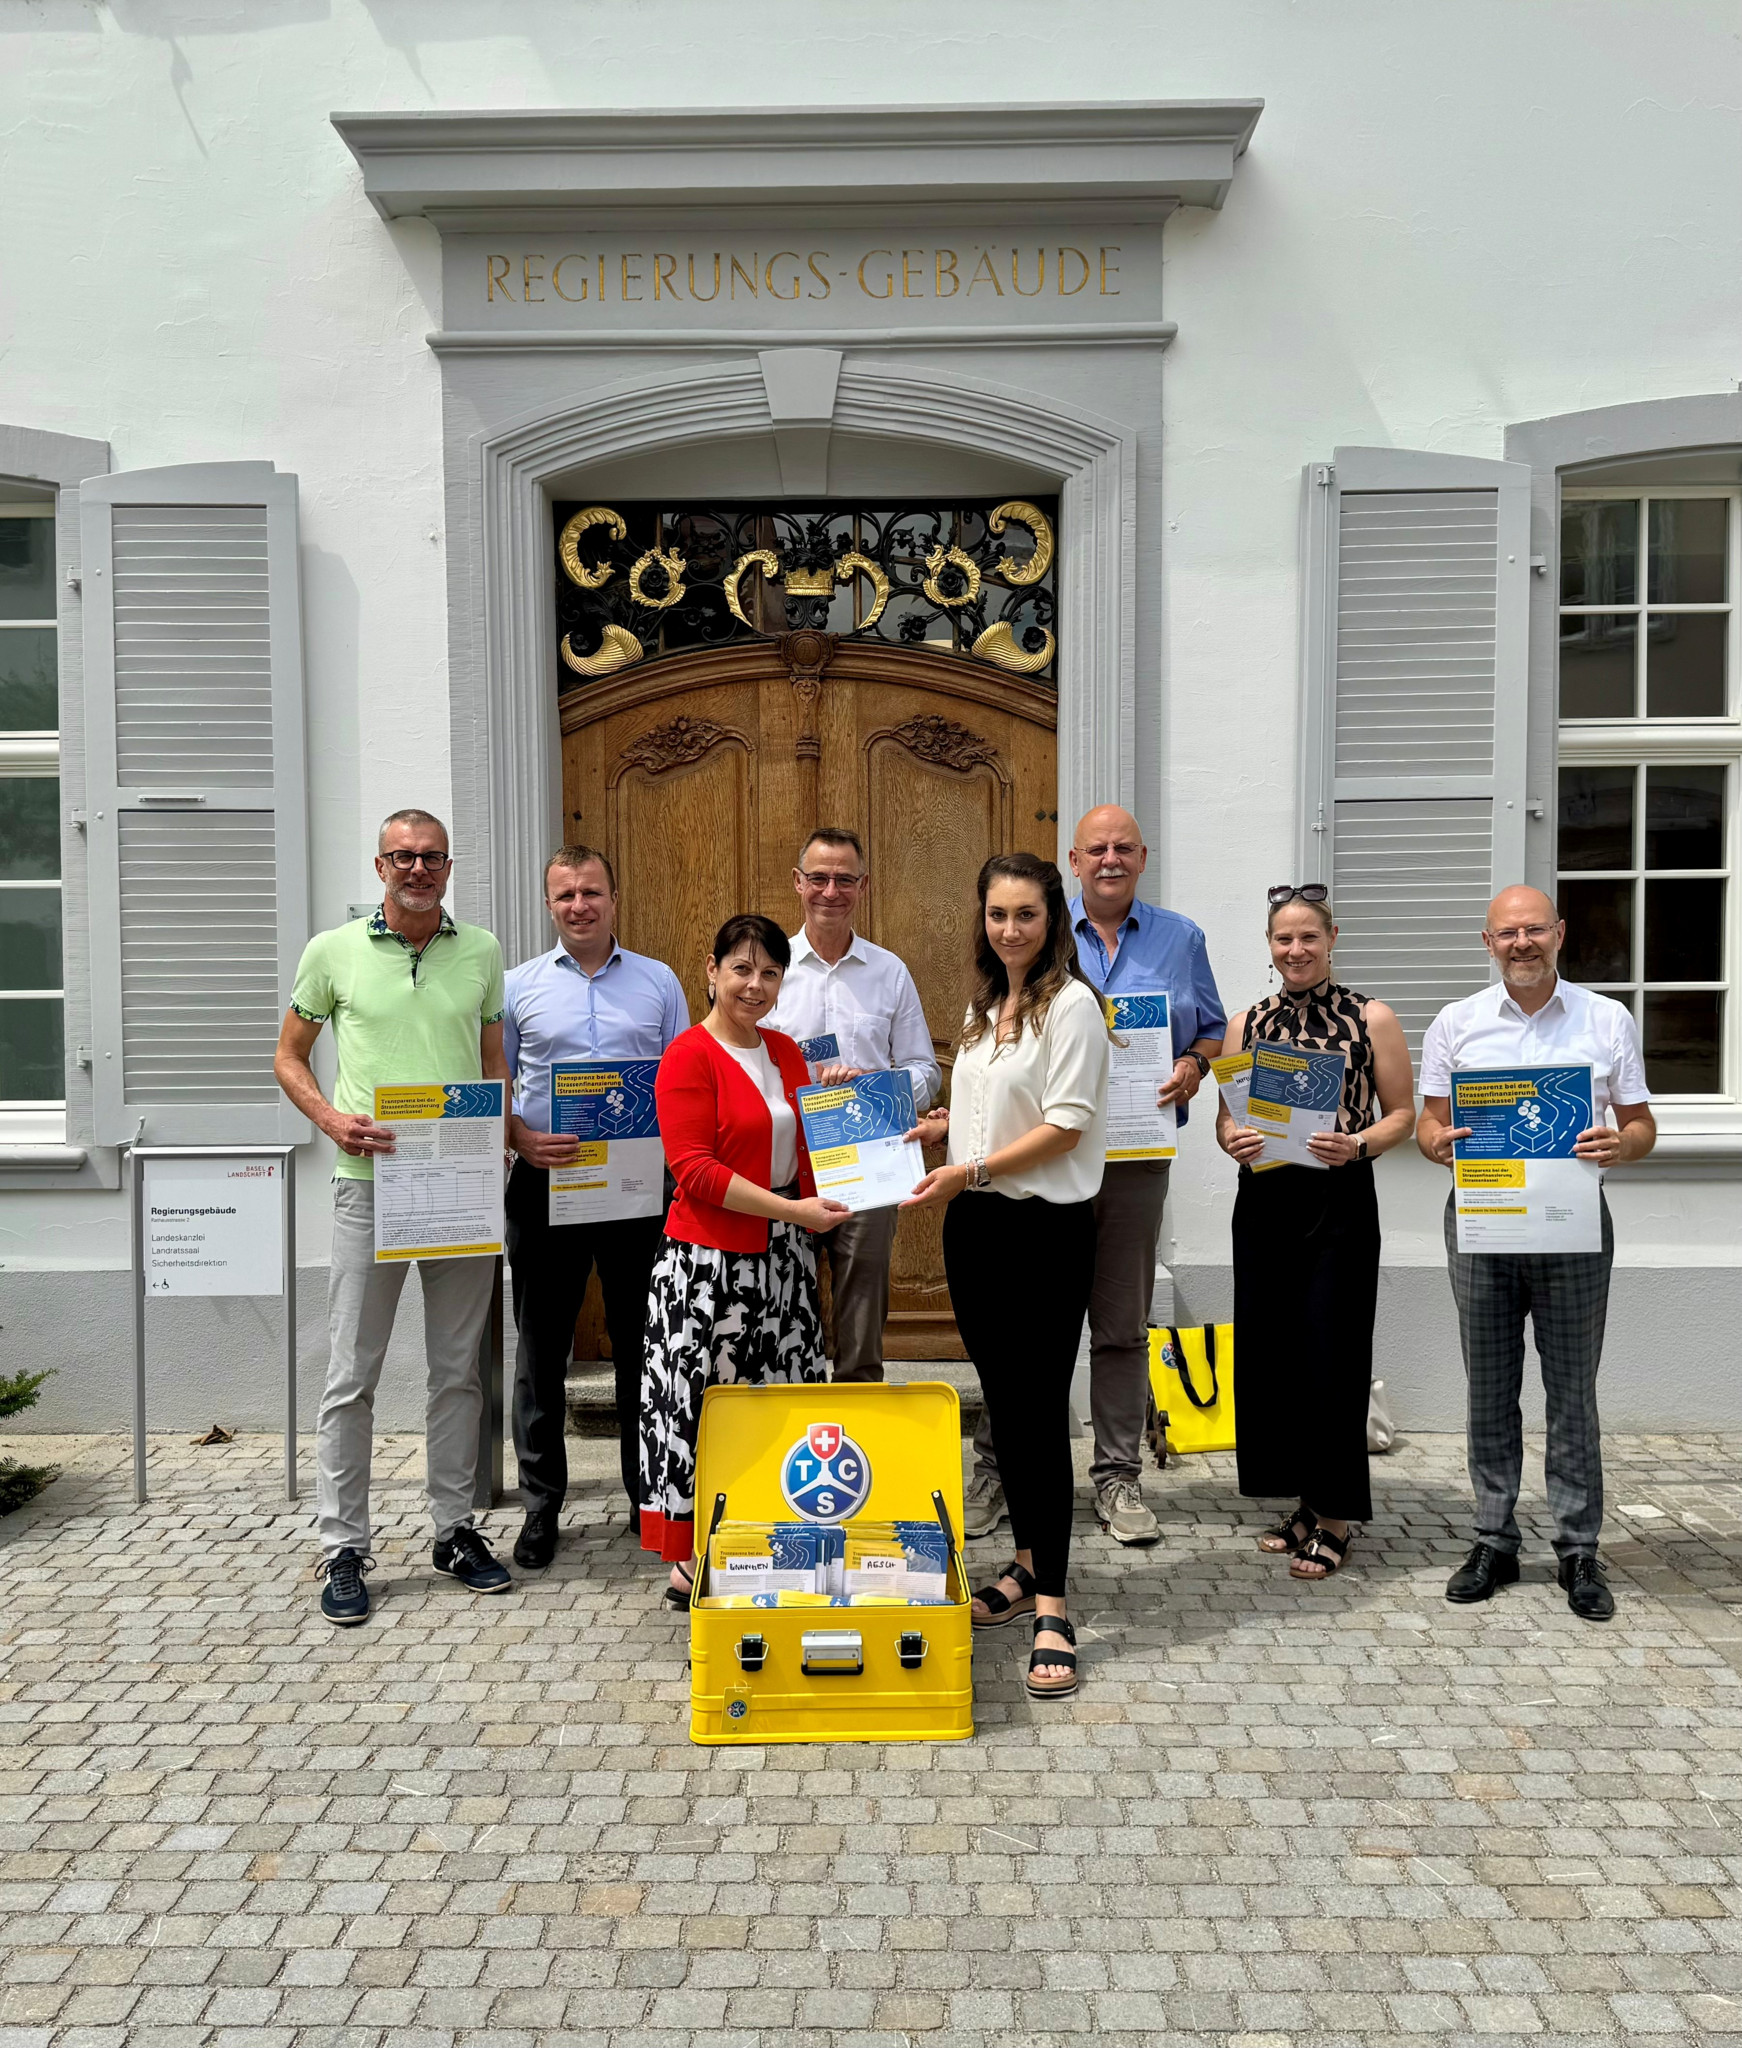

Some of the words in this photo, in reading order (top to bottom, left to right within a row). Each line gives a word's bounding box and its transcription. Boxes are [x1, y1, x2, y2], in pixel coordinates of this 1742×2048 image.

[486, 245, 1121, 302] REGIERUNGS-GEBÄUDE
[1458, 1090, 1536, 1098] Strassenfinanzierung
[150, 1207, 237, 1217] Regierungsgebäude
[151, 1233, 206, 1242] Landeskanzlei
[151, 1247, 200, 1255] Landratssaal
[151, 1259, 228, 1268] Sicherheitsdirektion
